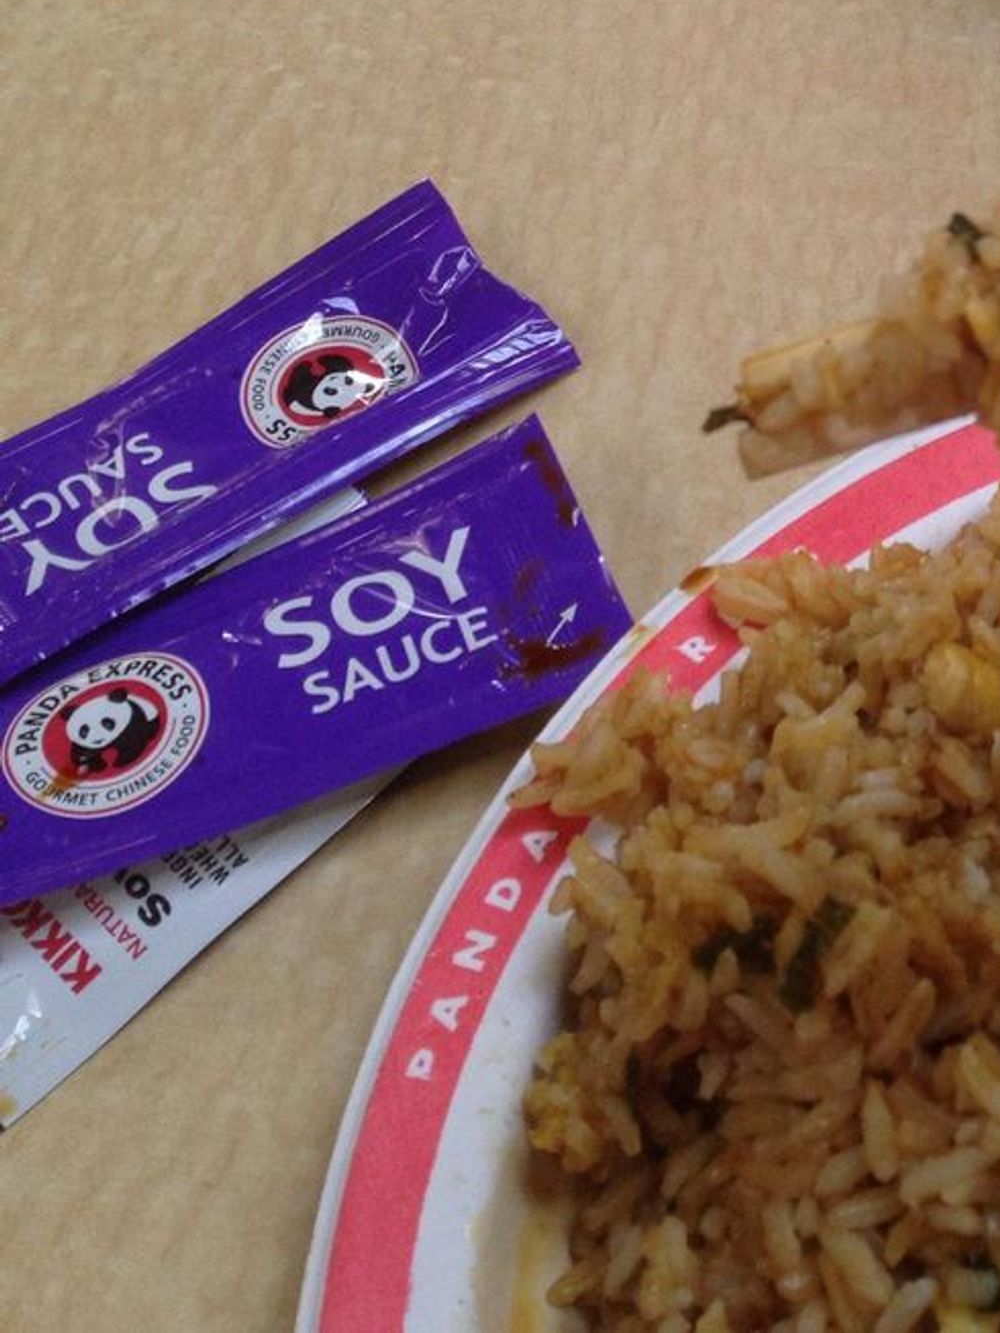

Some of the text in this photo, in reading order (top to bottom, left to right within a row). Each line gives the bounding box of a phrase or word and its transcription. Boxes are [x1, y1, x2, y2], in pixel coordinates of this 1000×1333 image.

[322, 325, 381, 343] GOURME
[252, 377, 267, 412] FOOD
[0, 432, 163, 542] SAUCE
[22, 461, 218, 596] SOY
[263, 526, 471, 669] SOY
[15, 660, 193, 756] PANDA EXPRESS
[303, 606, 498, 714] SAUCE
[26, 715, 196, 806] GOURMET CHINESE FOOD
[74, 882, 148, 961] NATURA
[406, 830, 556, 1080] PANDA
